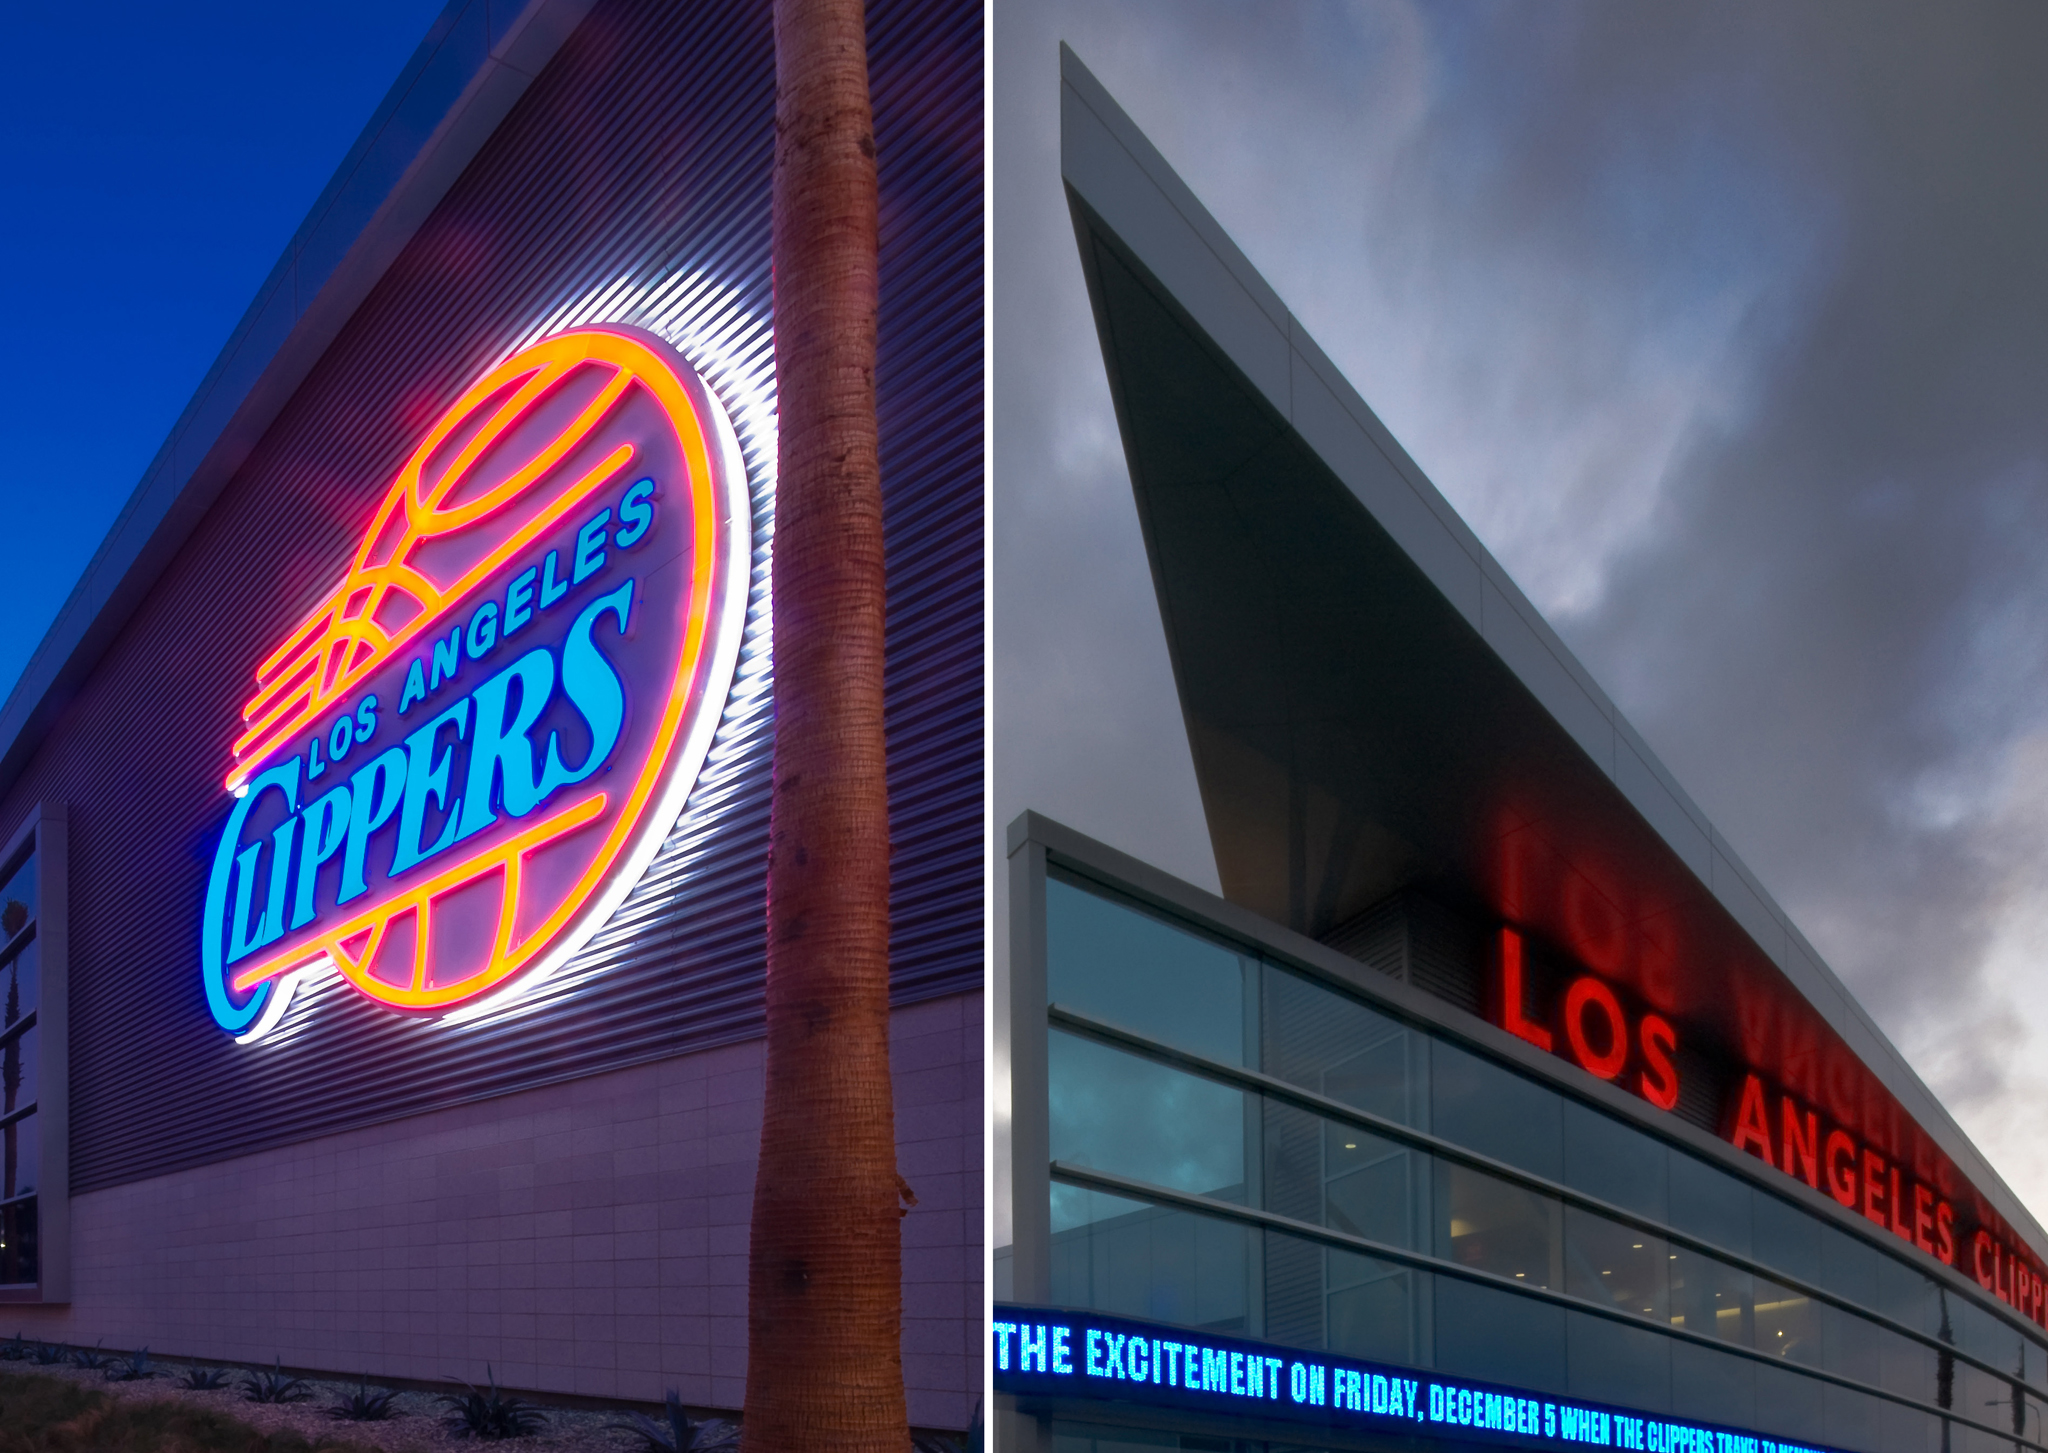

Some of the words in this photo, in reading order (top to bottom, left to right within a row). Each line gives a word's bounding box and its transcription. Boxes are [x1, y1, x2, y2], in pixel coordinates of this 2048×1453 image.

[306, 694, 379, 780] LOS
[398, 477, 655, 714] ANGELES
[201, 577, 635, 1034] CLIPPERS
[1502, 926, 1679, 1111] LOS
[1732, 1073, 1955, 1266] ANGELES
[993, 1321, 1073, 1374] THE
[1086, 1328, 1283, 1399] EXCITEMENT
[1291, 1362, 1325, 1406] ON
[1334, 1367, 1424, 1423] FRIDAY,
[1429, 1383, 1540, 1436] DECEMBER
[1544, 1403, 1556, 1438] 5
[1560, 1406, 1610, 1446] WHEN
[1613, 1415, 1645, 1451] THE
[1647, 1421, 1715, 1453] CLIPPERS
